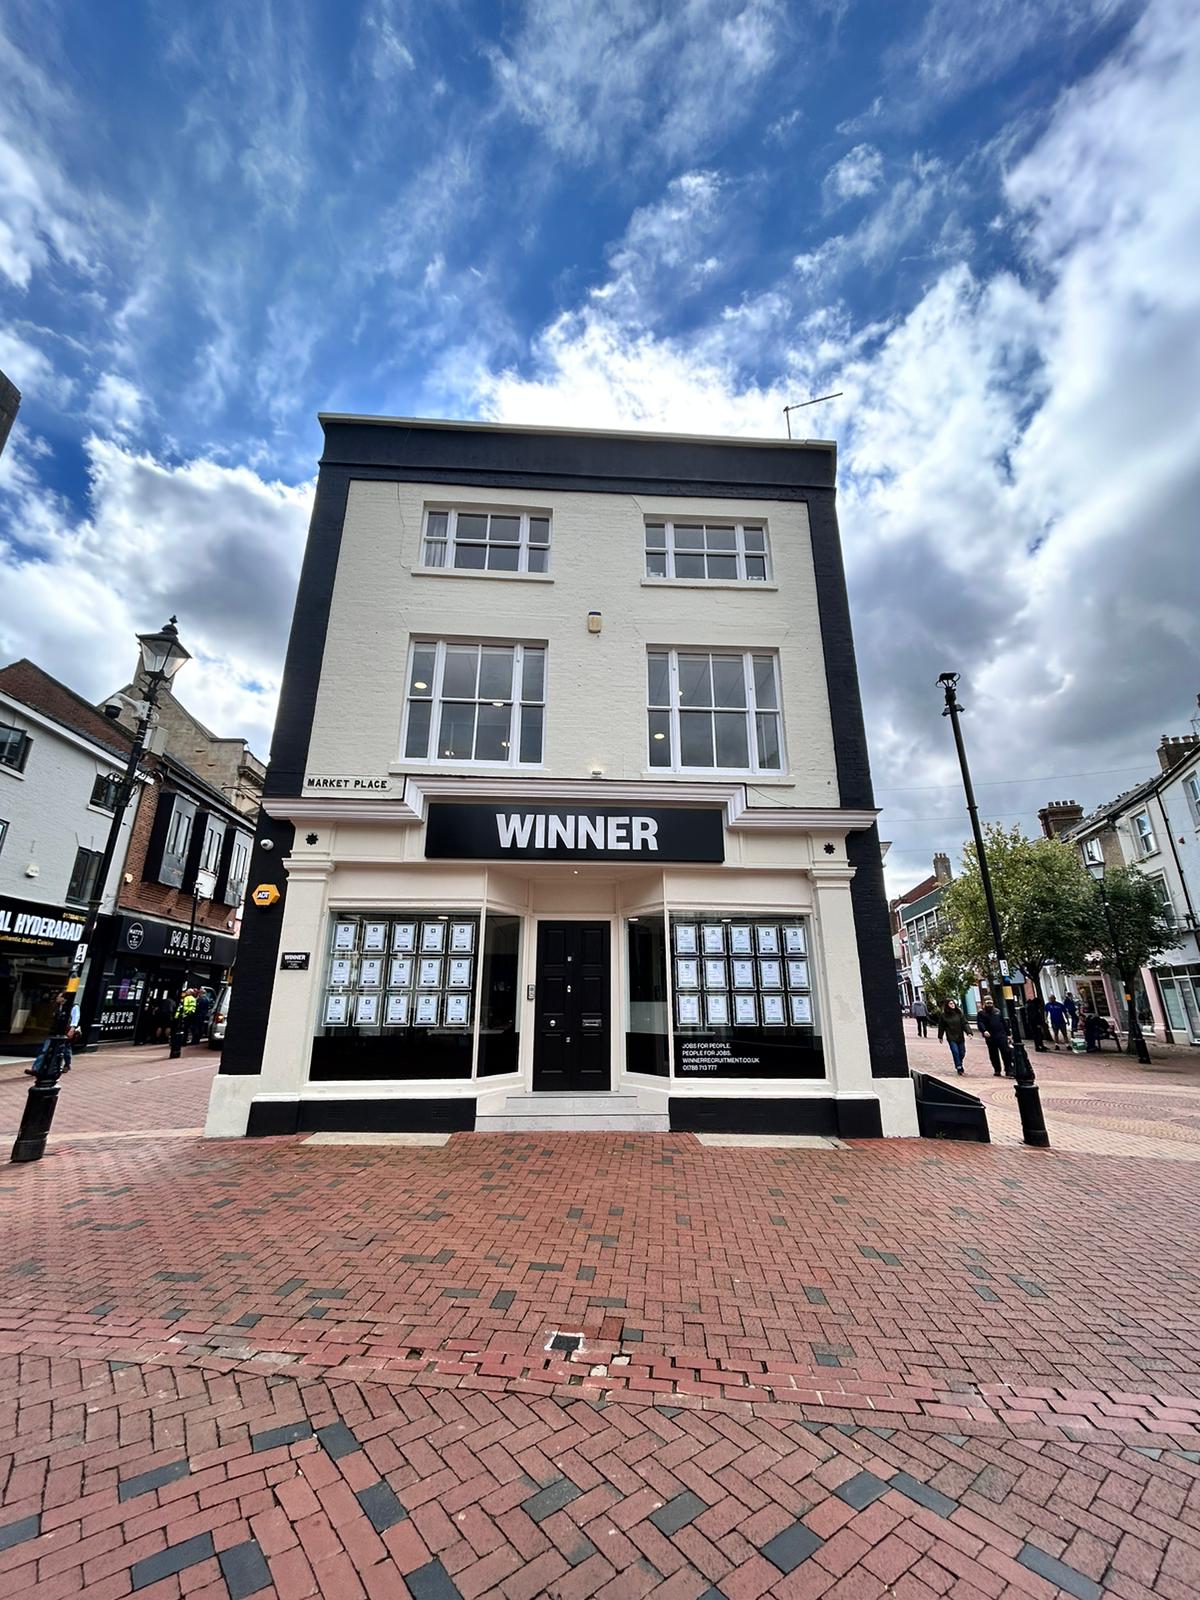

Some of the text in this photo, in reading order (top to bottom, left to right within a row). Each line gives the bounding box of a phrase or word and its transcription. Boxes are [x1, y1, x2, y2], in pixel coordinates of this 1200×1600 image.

[307, 778, 388, 788] MARKET PLACE
[495, 813, 659, 850] WINNER
[13, 913, 85, 942] HYDERABAD
[170, 930, 211, 952] MATT'S
[100, 1012, 134, 1024] MATT'S
